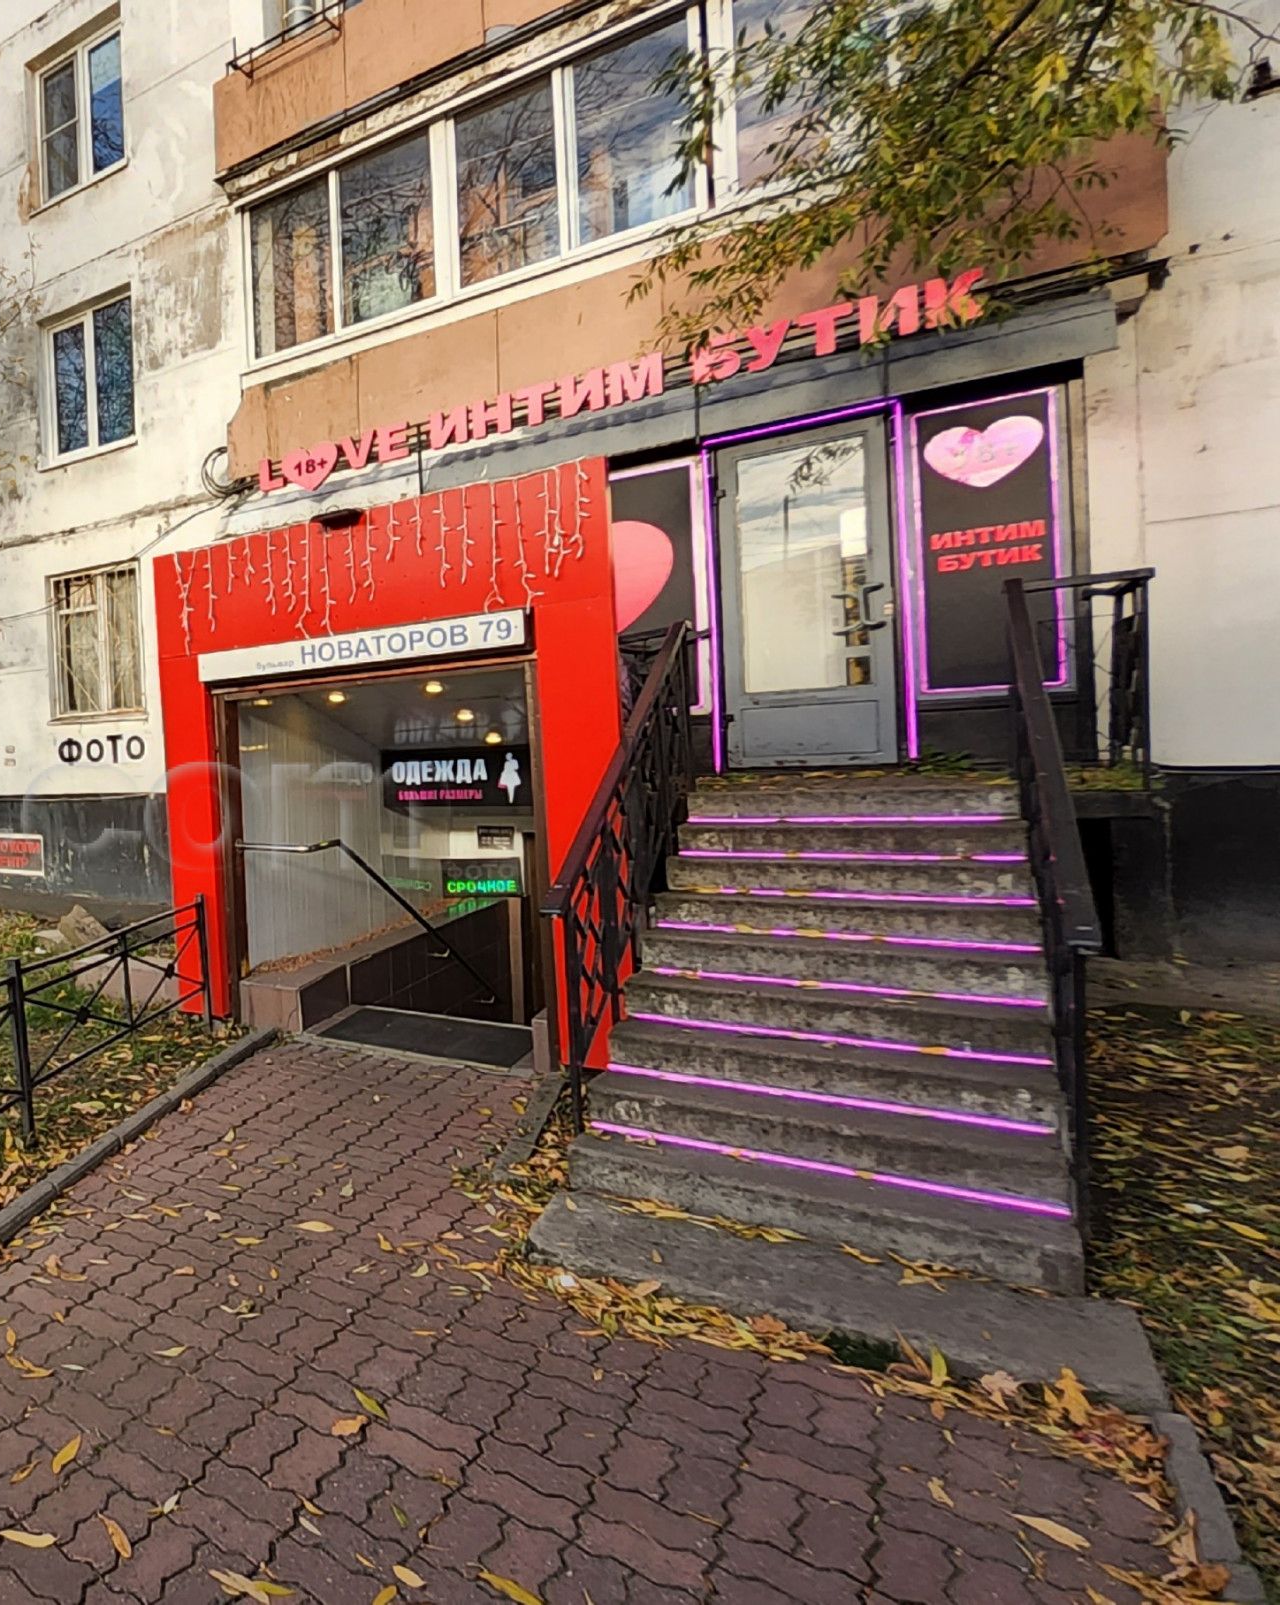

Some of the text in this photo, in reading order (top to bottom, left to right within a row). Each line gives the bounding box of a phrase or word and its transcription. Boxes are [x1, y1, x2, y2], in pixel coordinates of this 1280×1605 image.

[429, 267, 986, 450] ИНТИМ БУТИК
[294, 456, 329, 477] 18+
[930, 519, 1047, 550] ИНТИМ
[937, 543, 1043, 573] БУТИК
[300, 624, 469, 665] НОВАТОРОВ
[479, 618, 512, 643] 79
[58, 734, 146, 766] ФОТО
[391, 758, 488, 786] ОДЕЖДА
[446, 880, 517, 895] СРОЧНОЕ
